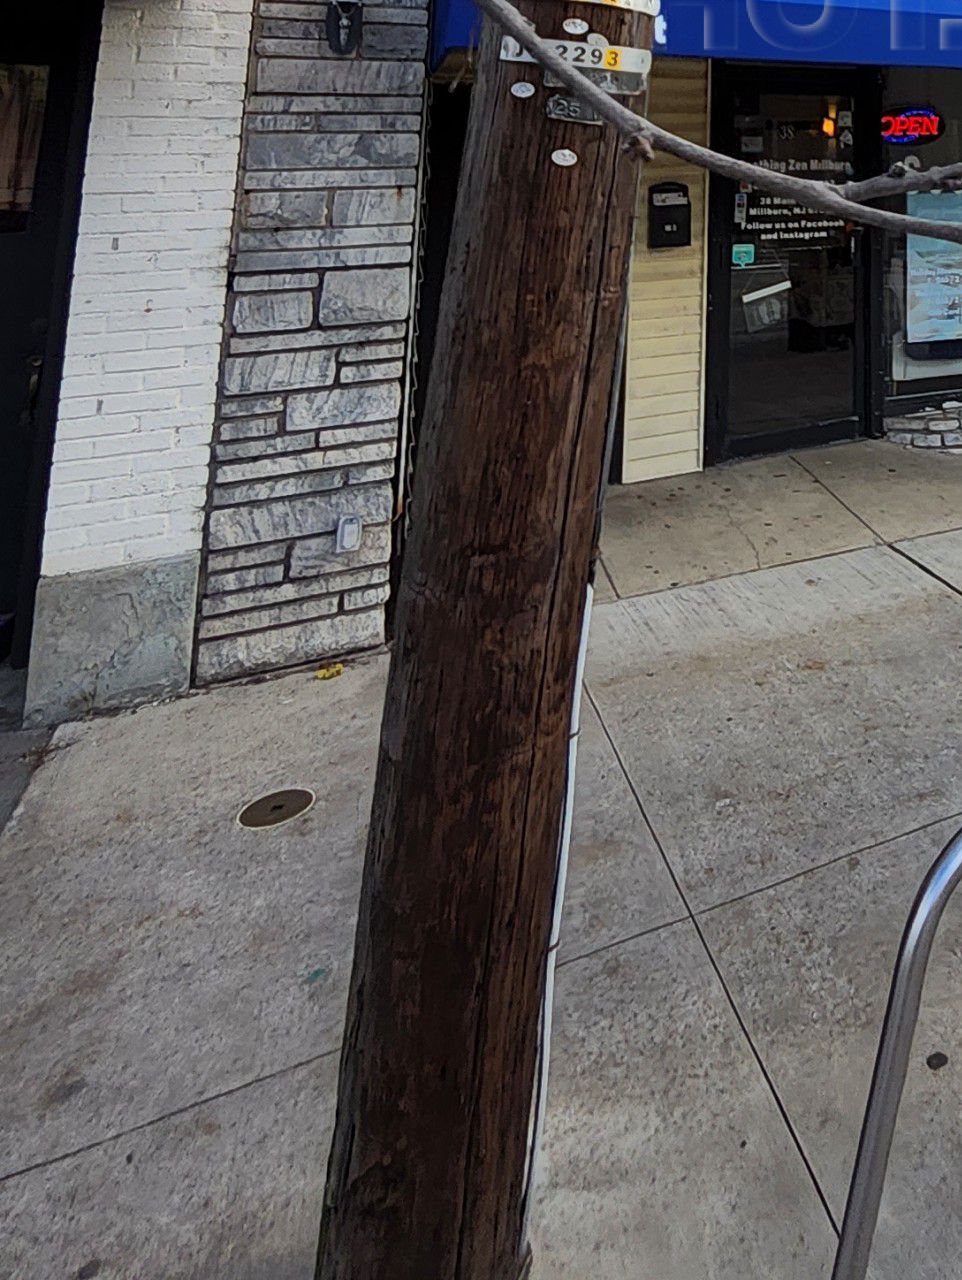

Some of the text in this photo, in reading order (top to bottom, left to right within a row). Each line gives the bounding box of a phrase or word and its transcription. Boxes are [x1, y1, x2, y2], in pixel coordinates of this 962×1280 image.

[554, 45, 620, 67] 2293
[881, 115, 940, 136] OPEN
[788, 159, 809, 170] Zen
[740, 221, 773, 230] Follow
[787, 221, 800, 229] on
[800, 219, 845, 228] Facebook
[760, 231, 828, 240] and Instagram
